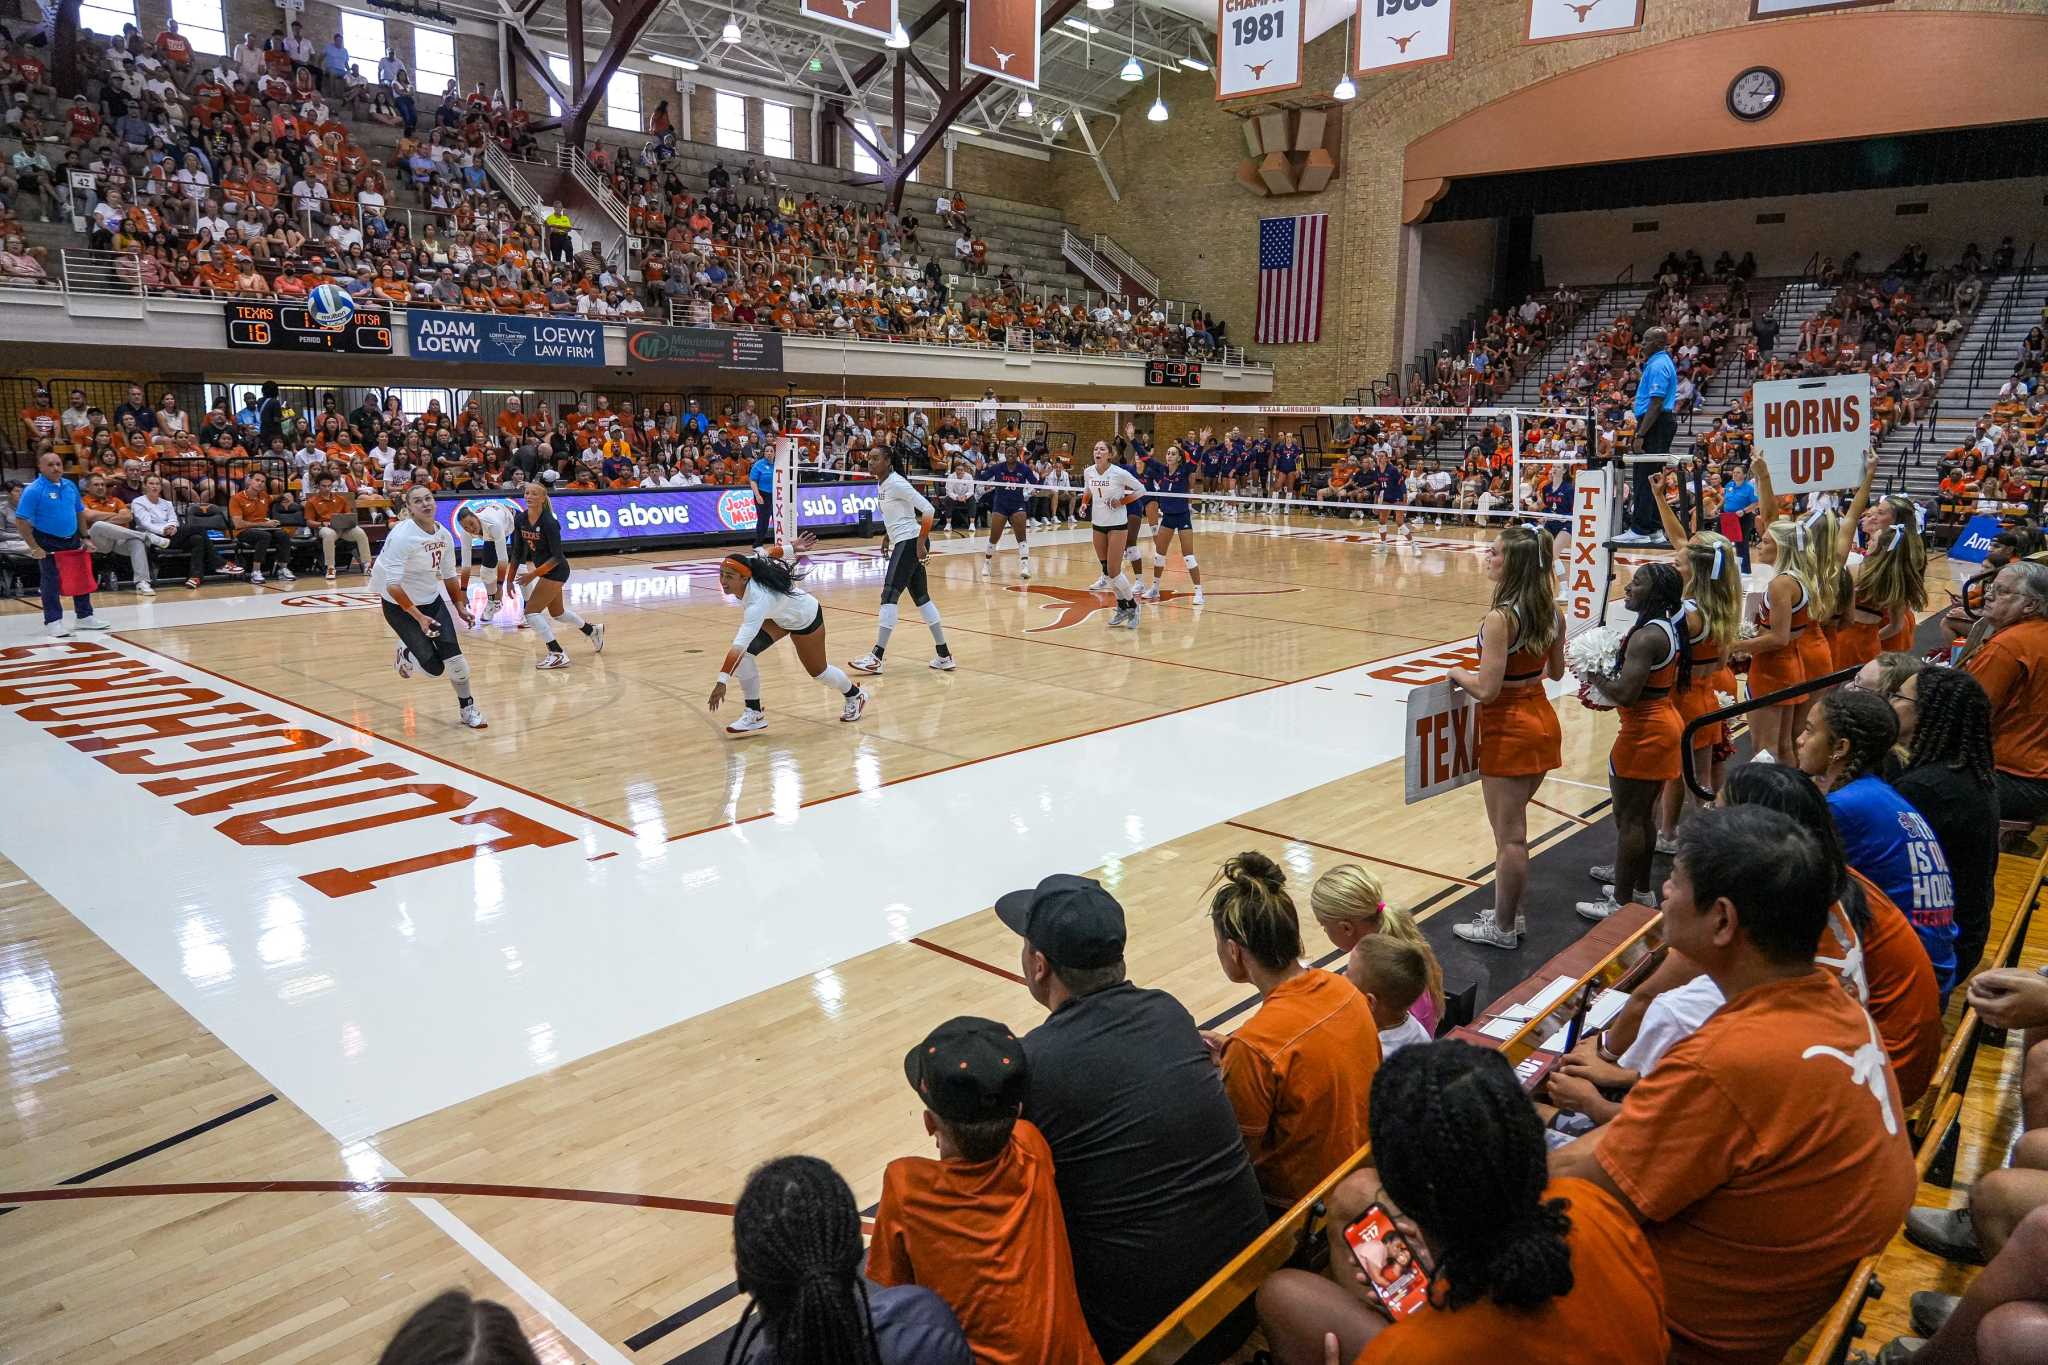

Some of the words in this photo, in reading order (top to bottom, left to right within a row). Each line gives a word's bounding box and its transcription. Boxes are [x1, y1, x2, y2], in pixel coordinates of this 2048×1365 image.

[1232, 10, 1284, 46] 1981
[236, 306, 274, 320] TEXAS
[354, 313, 381, 326] UTSA
[248, 324, 268, 343] 16
[420, 319, 475, 337] ADAM
[533, 326, 596, 345] LOEWY
[299, 336, 321, 344] PERIOD
[377, 330, 389, 347] 9
[417, 336, 481, 354] LOEWY
[535, 344, 563, 357] LAW
[566, 345, 594, 359] FIRM
[1764, 394, 1860, 438] HORNS
[1790, 446, 1835, 485] UP
[726, 497, 757, 511] Jerse
[775, 469, 784, 547] TEXAS
[802, 494, 837, 517] sub
[566, 504, 611, 530] sub
[617, 502, 689, 526] above
[1963, 532, 1991, 551] Am
[431, 550, 442, 569] 13
[1572, 487, 1601, 619] TEXAS
[0, 641, 578, 898] LONGHORNS
[1907, 841, 1933, 875] IS
[1928, 840, 1950, 873] OU
[1912, 873, 1955, 909] HOUS
